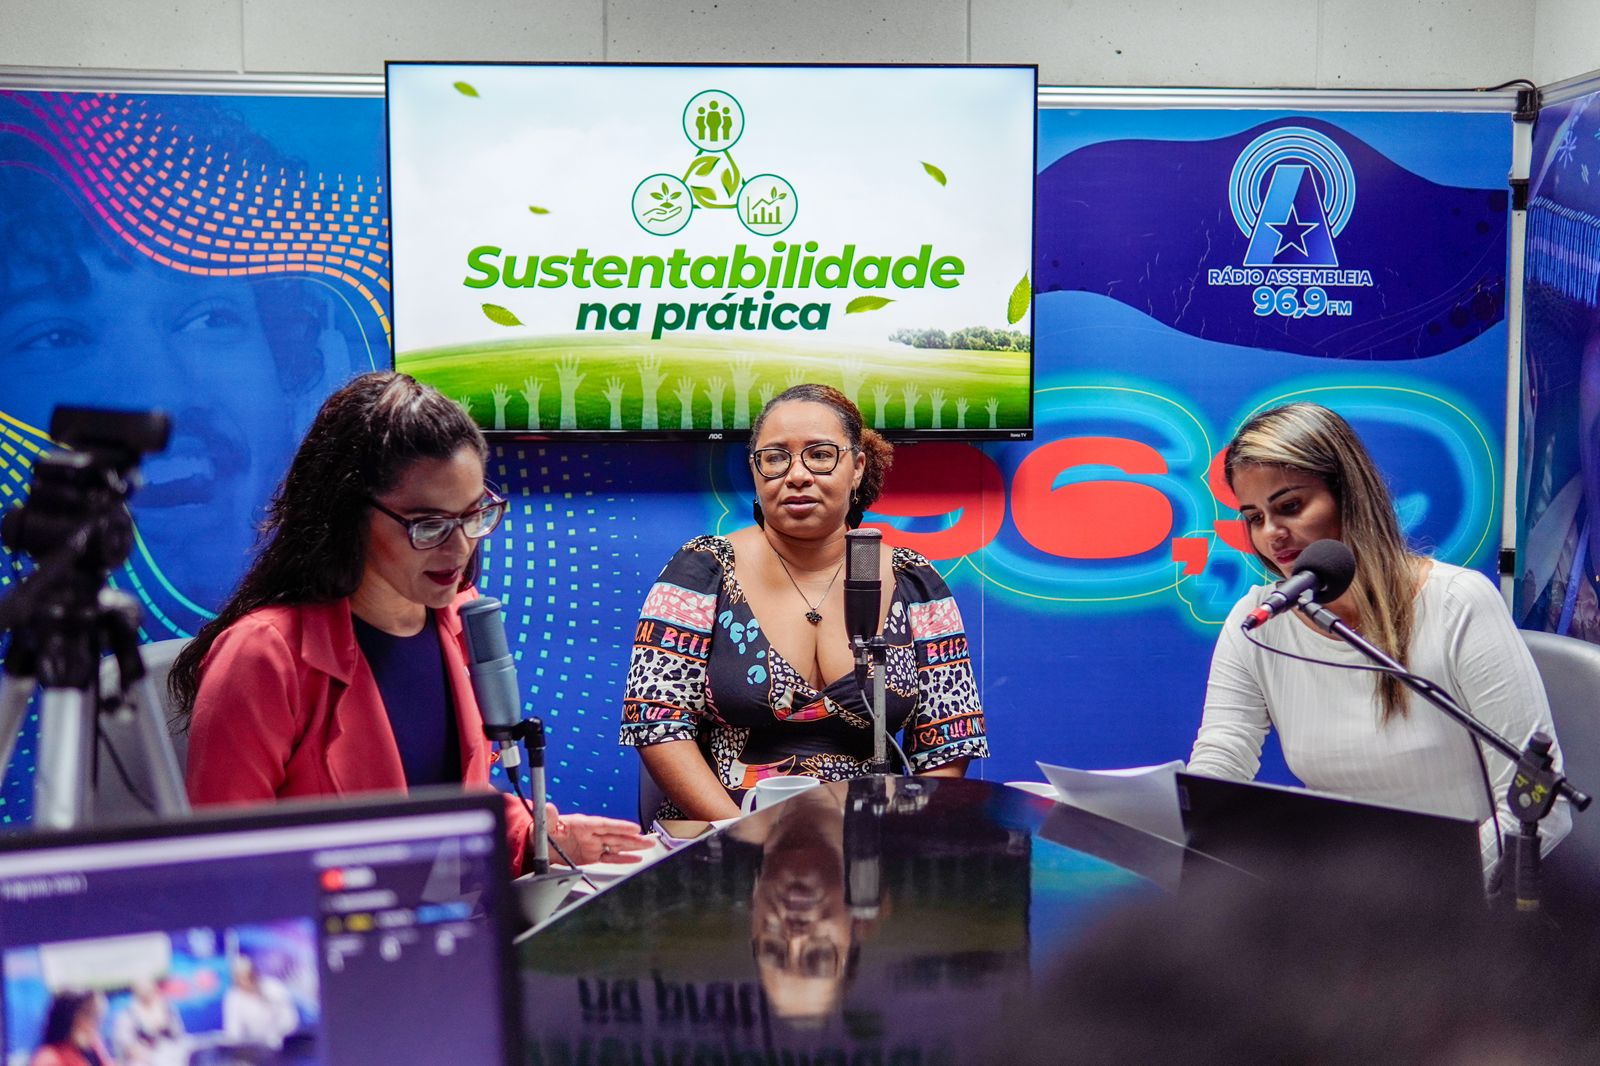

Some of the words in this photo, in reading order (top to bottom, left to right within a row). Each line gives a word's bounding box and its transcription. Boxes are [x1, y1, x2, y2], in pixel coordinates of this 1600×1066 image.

[463, 240, 966, 290] Sustentabilidade
[1208, 265, 1265, 286] RÁDIO
[1265, 268, 1374, 287] ASSEMBLEIA
[575, 302, 642, 331] na
[650, 290, 832, 340] prática
[1252, 286, 1328, 319] 96,9
[1327, 300, 1352, 316] FM
[858, 436, 1257, 576] 96,
[926, 637, 970, 665] BELEZ
